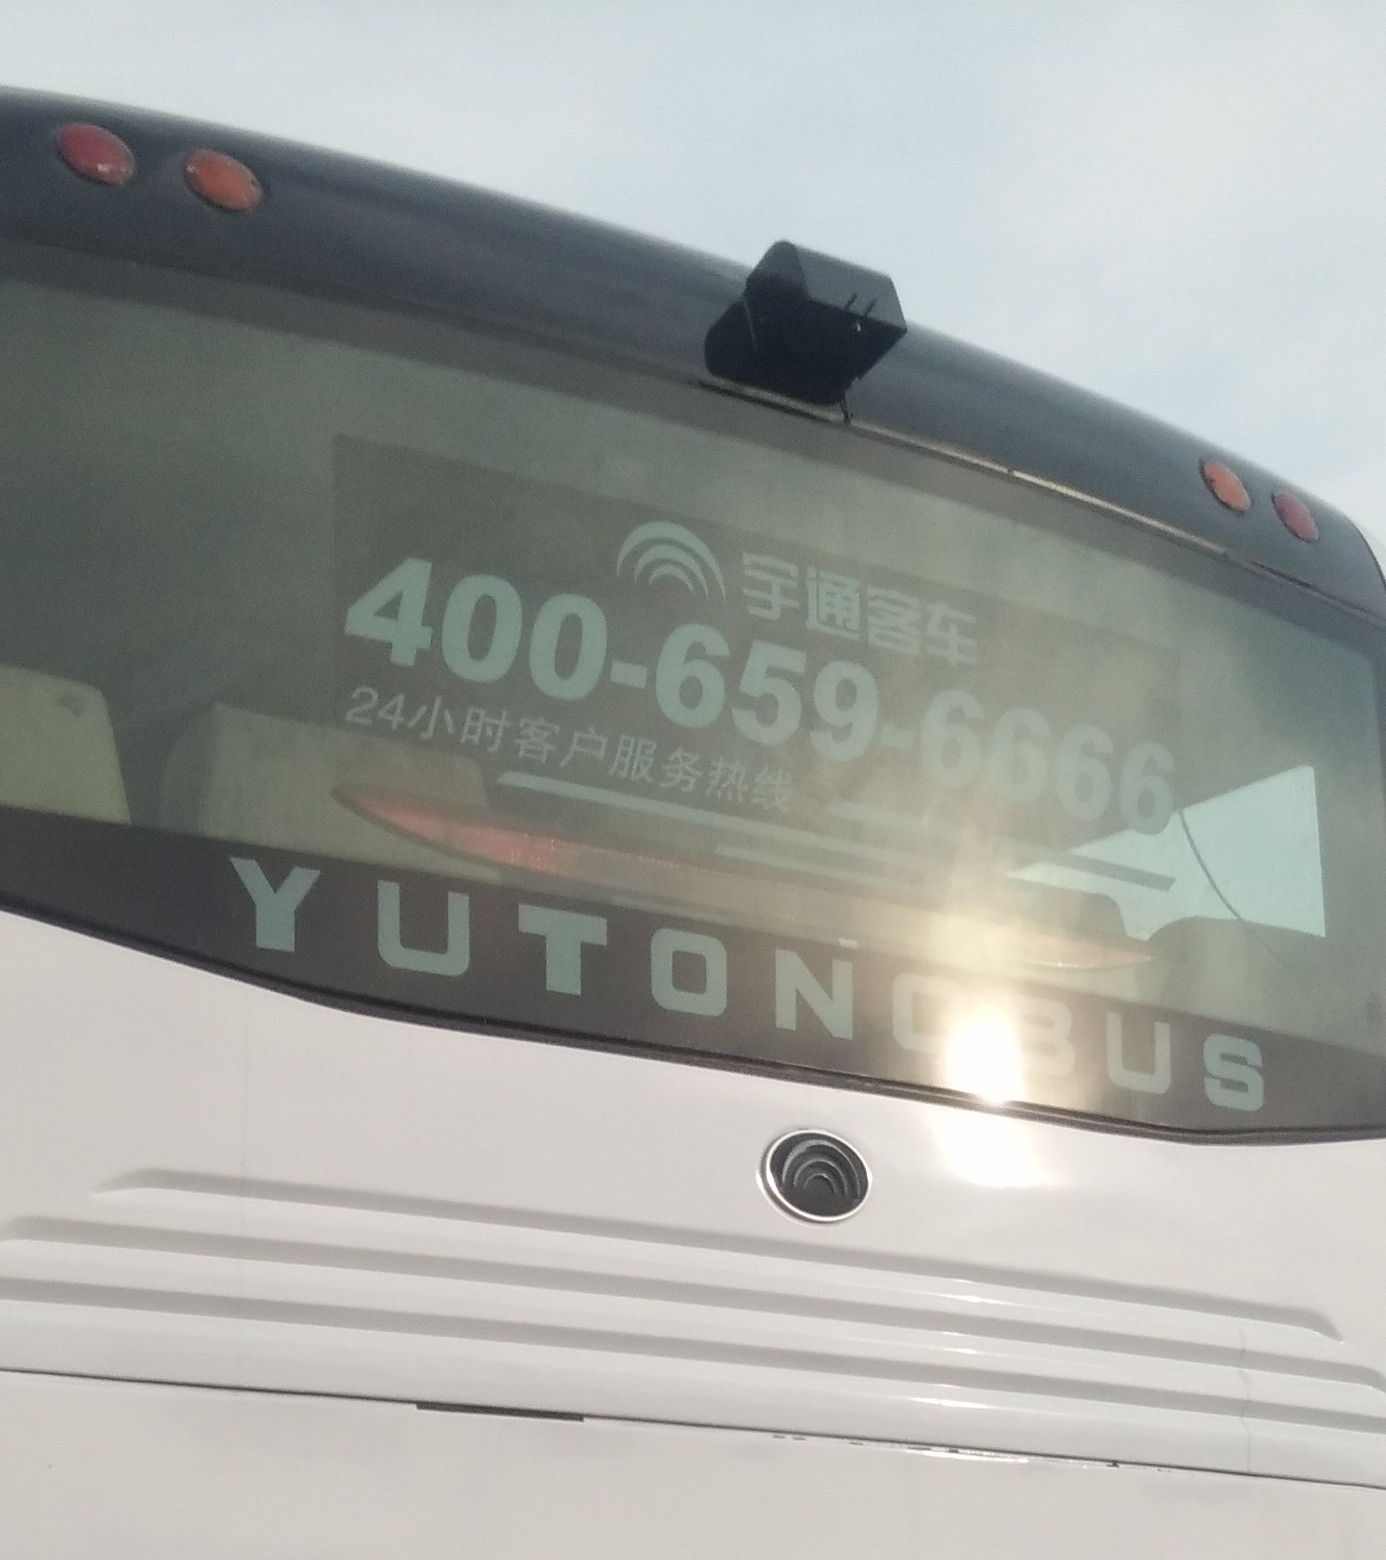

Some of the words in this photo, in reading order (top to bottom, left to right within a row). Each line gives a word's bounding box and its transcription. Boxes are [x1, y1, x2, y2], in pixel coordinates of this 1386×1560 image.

[344, 557, 1176, 835] 400-659-6666
[741, 551, 980, 667] 宇通客车
